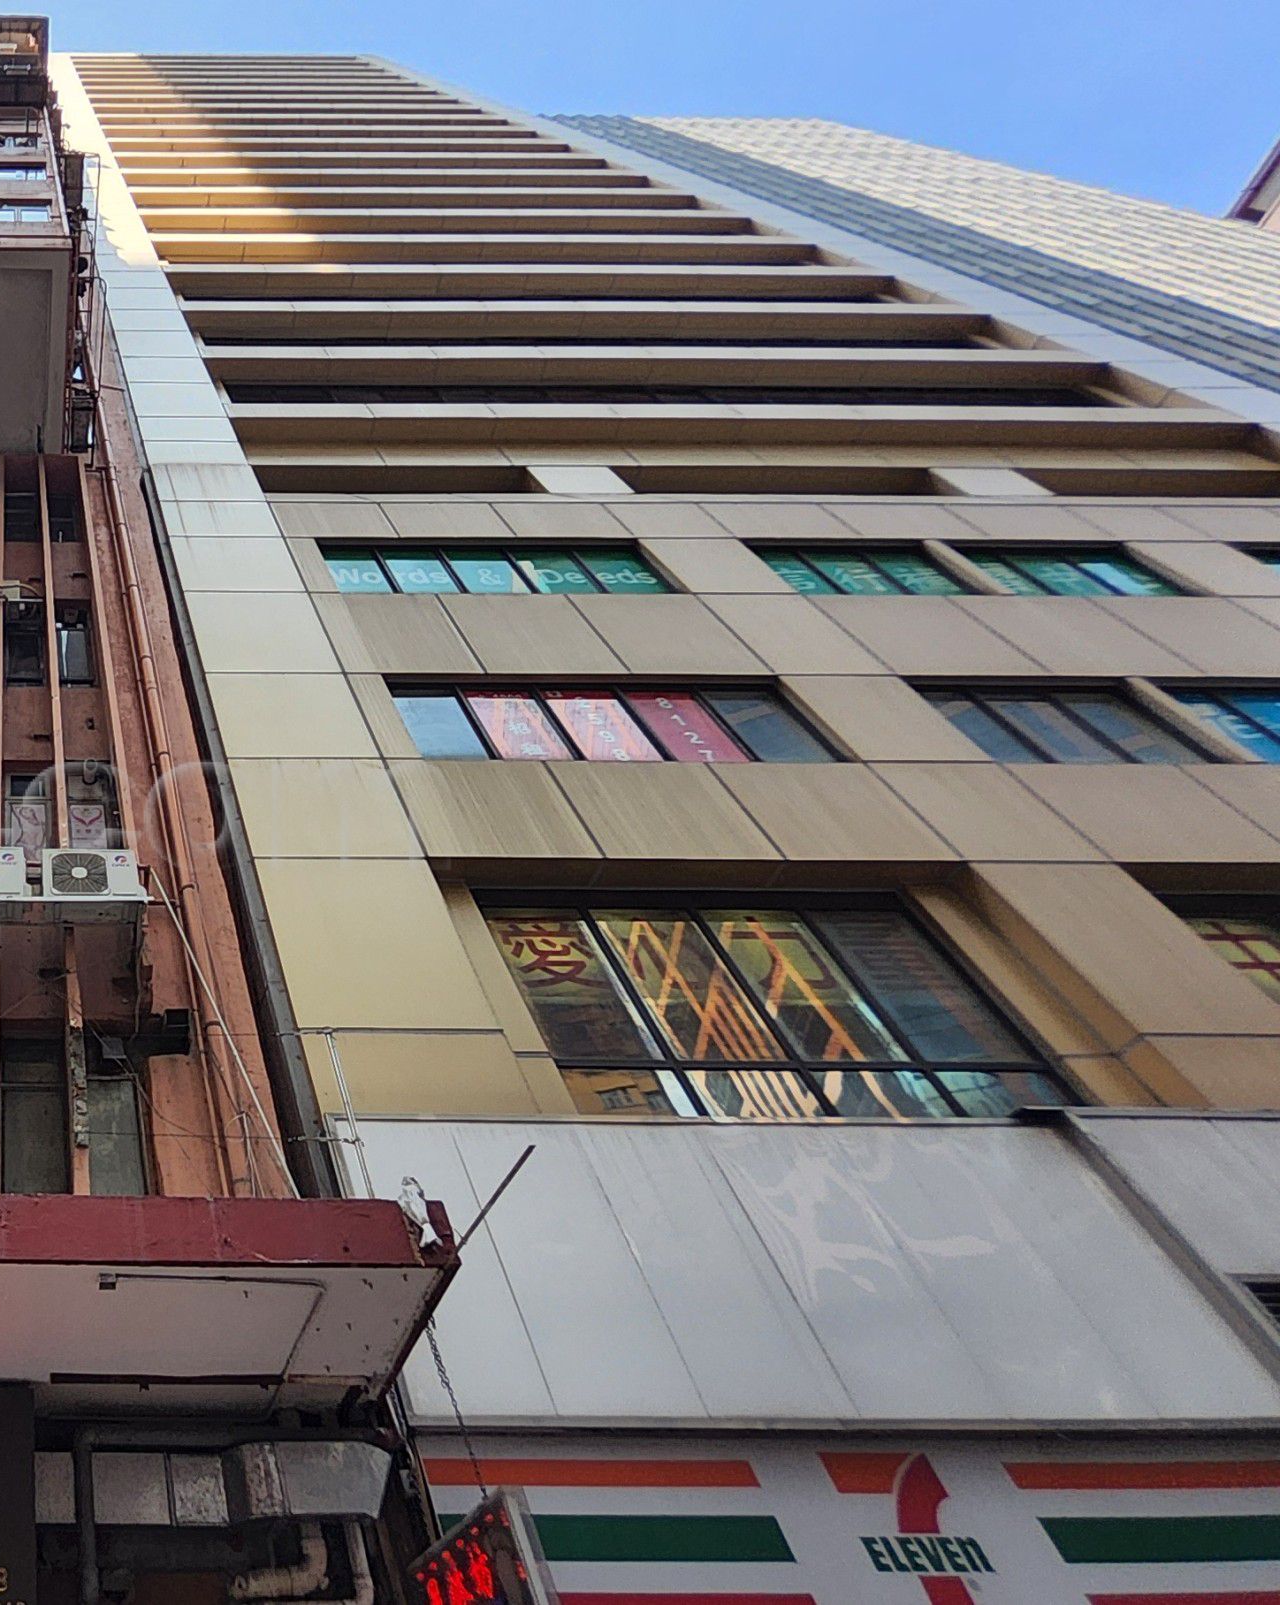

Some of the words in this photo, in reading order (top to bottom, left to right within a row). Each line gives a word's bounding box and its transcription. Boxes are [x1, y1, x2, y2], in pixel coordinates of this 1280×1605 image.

[329, 566, 447, 586] Words
[477, 567, 506, 587] &
[537, 567, 659, 586] Deeds
